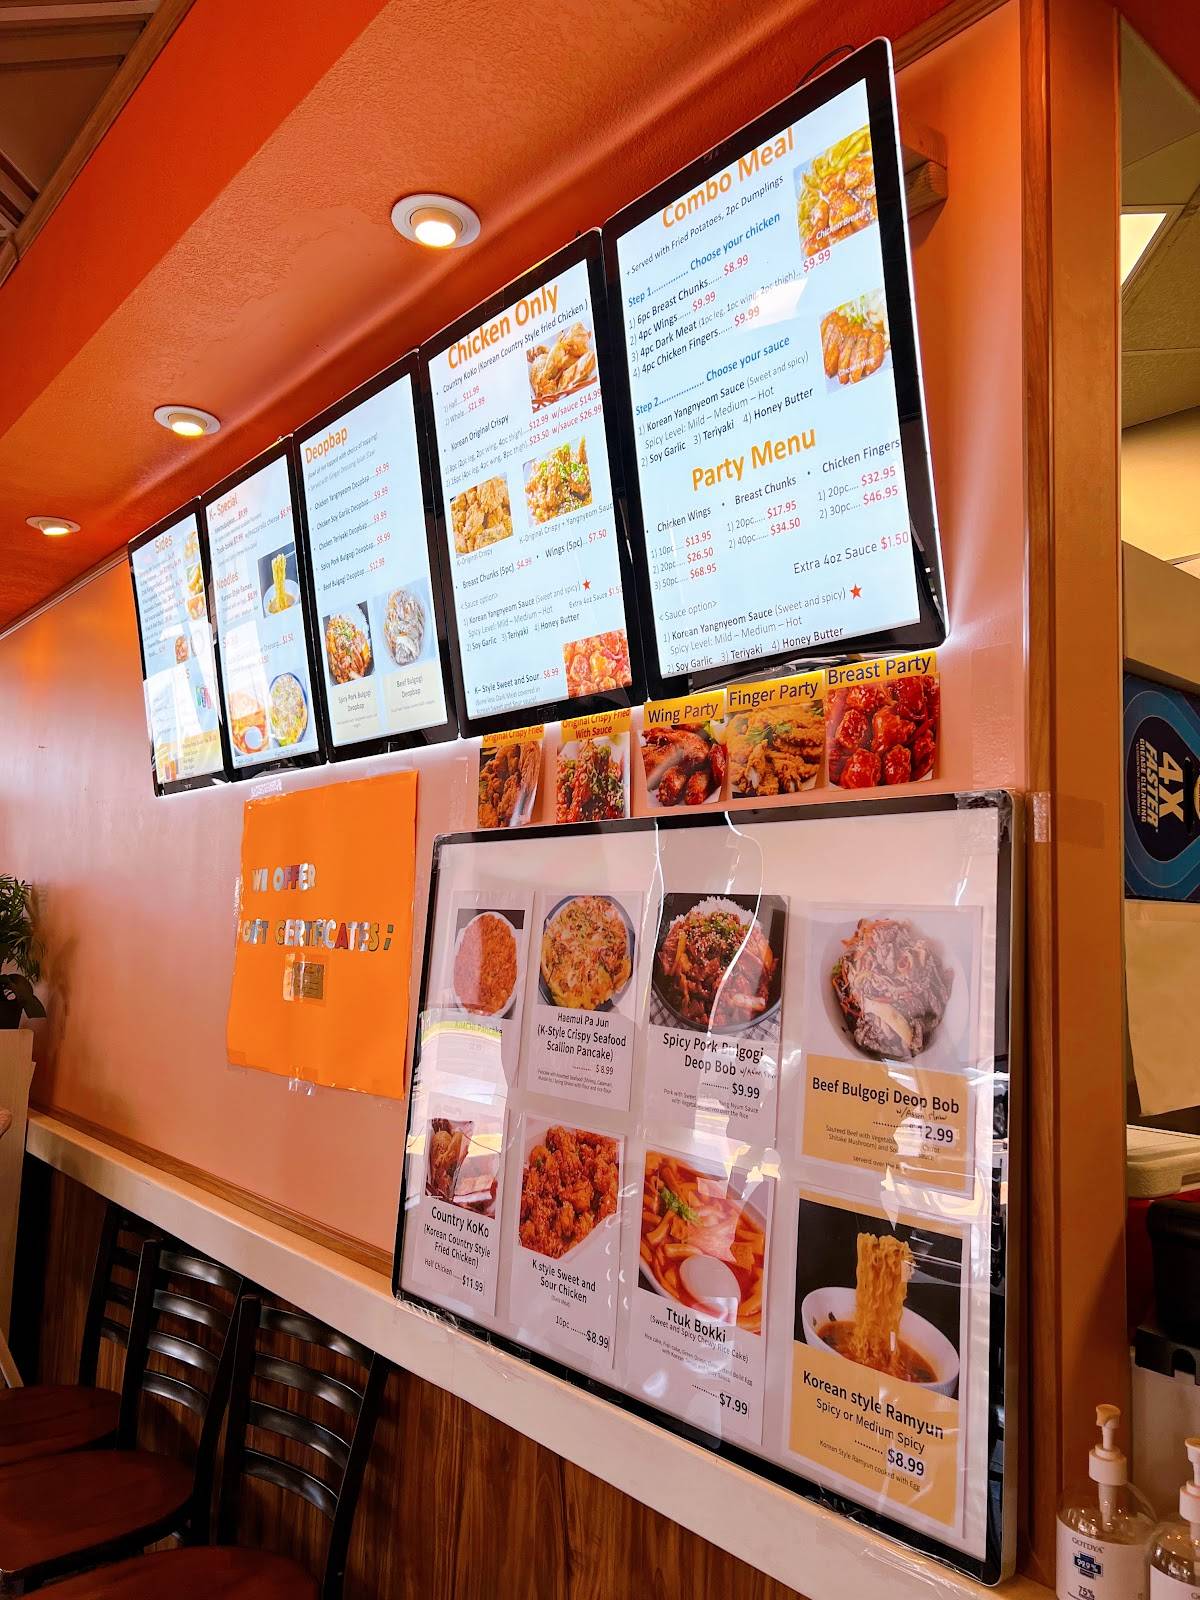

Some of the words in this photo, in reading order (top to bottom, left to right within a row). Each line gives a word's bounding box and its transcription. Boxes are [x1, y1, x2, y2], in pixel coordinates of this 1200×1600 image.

[661, 173, 733, 229] Combo
[736, 127, 795, 182] Meal
[631, 253, 653, 273] Served
[671, 231, 688, 249] Fried
[690, 214, 723, 237] Potatoes,
[741, 175, 783, 206] Dumplings
[628, 292, 645, 307] Step
[690, 247, 721, 270] Choose
[722, 230, 750, 254] your
[750, 213, 779, 236] chicken
[651, 296, 676, 315] Breast
[724, 254, 748, 275] $8.99
[655, 332, 673, 349] Dark
[675, 320, 696, 338] Meat
[803, 249, 830, 272] $9.99
[692, 291, 716, 311] $9.99
[447, 318, 511, 370] Chicken
[514, 283, 560, 327] Only
[500, 339, 523, 357] Country
[524, 329, 539, 343] Style
[557, 303, 583, 323] Chicken
[656, 345, 686, 365] Chicken
[734, 306, 759, 326] $9.99
[706, 361, 737, 381] Choose
[739, 350, 760, 367] your
[763, 337, 789, 355] sauce
[528, 414, 549, 431] $12.99
[551, 401, 579, 419] w/sauce
[579, 386, 602, 405] $14.99
[551, 415, 578, 433] w/sauce
[579, 401, 603, 421] $26.99
[646, 414, 672, 431] Korean
[673, 393, 718, 418] Yangnyeom
[720, 381, 744, 398] Sauce
[468, 422, 490, 440] Original
[490, 415, 508, 428] Crispy
[649, 452, 662, 463] Soy
[664, 441, 685, 456] Garlic
[703, 419, 733, 439] Teriyaki
[754, 401, 782, 419] Honey
[784, 388, 812, 406] Butter
[304, 424, 348, 464] Deopbap
[822, 453, 860, 472] Chicken
[863, 439, 899, 458] Fingers
[692, 456, 743, 490] Party
[751, 429, 815, 468] Menu
[735, 488, 762, 504] Breast
[764, 476, 796, 494] Chunks
[861, 466, 895, 486] $32.95
[863, 485, 897, 504] $46.95
[657, 516, 685, 531] Chicken
[687, 507, 711, 521] Wings
[767, 500, 796, 519] $17.95
[770, 517, 800, 535] $34.50
[154, 530, 173, 553] Sides
[545, 545, 564, 557] Wings
[566, 537, 582, 552] (5pc)
[588, 528, 606, 543] $7.50
[793, 559, 820, 574] Extra
[823, 553, 841, 564] 4oz
[845, 543, 877, 559] Sauce
[880, 531, 908, 549] $1.50
[499, 562, 514, 576] (5pc)
[517, 598, 534, 608] Sauce
[559, 613, 579, 624] Butter
[671, 627, 698, 640] Korean
[700, 615, 746, 632] Yangnyeom
[748, 608, 772, 621] Sauce
[674, 662, 689, 671] Soy
[689, 656, 712, 668] Garlic
[730, 643, 762, 659] Teriyaki
[782, 635, 810, 647] Honey
[813, 628, 843, 641] Butter
[828, 663, 880, 684] Breast
[886, 651, 931, 675] Party
[496, 679, 513, 689] Sweet
[729, 689, 775, 707] Finger
[779, 675, 818, 698] Party
[648, 708, 679, 723] Wing
[684, 703, 718, 718] Party
[575, 727, 591, 739] With
[591, 724, 613, 737] Sauce
[1145, 740, 1159, 830] FASTER
[1158, 751, 1184, 822] 4X
[272, 863, 316, 892] OFFER
[557, 1013, 583, 1024] Haemul
[584, 1015, 594, 1025] Pa
[595, 1017, 608, 1027] Jun
[537, 1024, 565, 1039] (K-Style
[567, 1028, 591, 1043] Crispy
[593, 1032, 626, 1046] Seafood
[663, 1032, 690, 1051] Spicy
[693, 1037, 717, 1052] Pork
[546, 1040, 574, 1053] Scallion
[576, 1045, 613, 1061] Pancake)
[684, 1054, 711, 1072] Deop
[715, 1060, 736, 1075] Bob
[732, 1082, 759, 1099] $9.99
[813, 1077, 839, 1092] Beef
[842, 1082, 888, 1104] Bulgogi
[932, 1096, 959, 1113] Bob
[431, 1206, 464, 1231] Country
[466, 1219, 488, 1237] KoKo
[434, 1241, 449, 1255] Fried
[451, 1248, 479, 1268] Chicken)
[448, 1233, 473, 1252] Country
[474, 1243, 491, 1257] Style
[540, 1276, 556, 1290] Sour
[558, 1283, 586, 1303] Chicken
[557, 1268, 579, 1285] Sweet
[581, 1280, 595, 1291] and
[586, 1330, 608, 1348] $8.99
[650, 1314, 668, 1328] (Sweet
[669, 1323, 680, 1333] and
[681, 1326, 696, 1342] Spicy
[697, 1334, 717, 1350] Chewy
[717, 1340, 731, 1356] Rice
[731, 1345, 749, 1363] Cake)
[666, 1307, 690, 1329] Ttuk
[694, 1319, 725, 1342] Bokki
[719, 1393, 747, 1415] $7.99
[803, 1370, 846, 1399] Korean
[851, 1392, 881, 1413] style
[886, 1403, 943, 1439] Ramyun
[816, 1398, 840, 1418] Spicy
[843, 1411, 853, 1421] or
[856, 1414, 893, 1438] Medium
[897, 1432, 924, 1454] Spicy
[887, 1449, 924, 1475] $8.99
